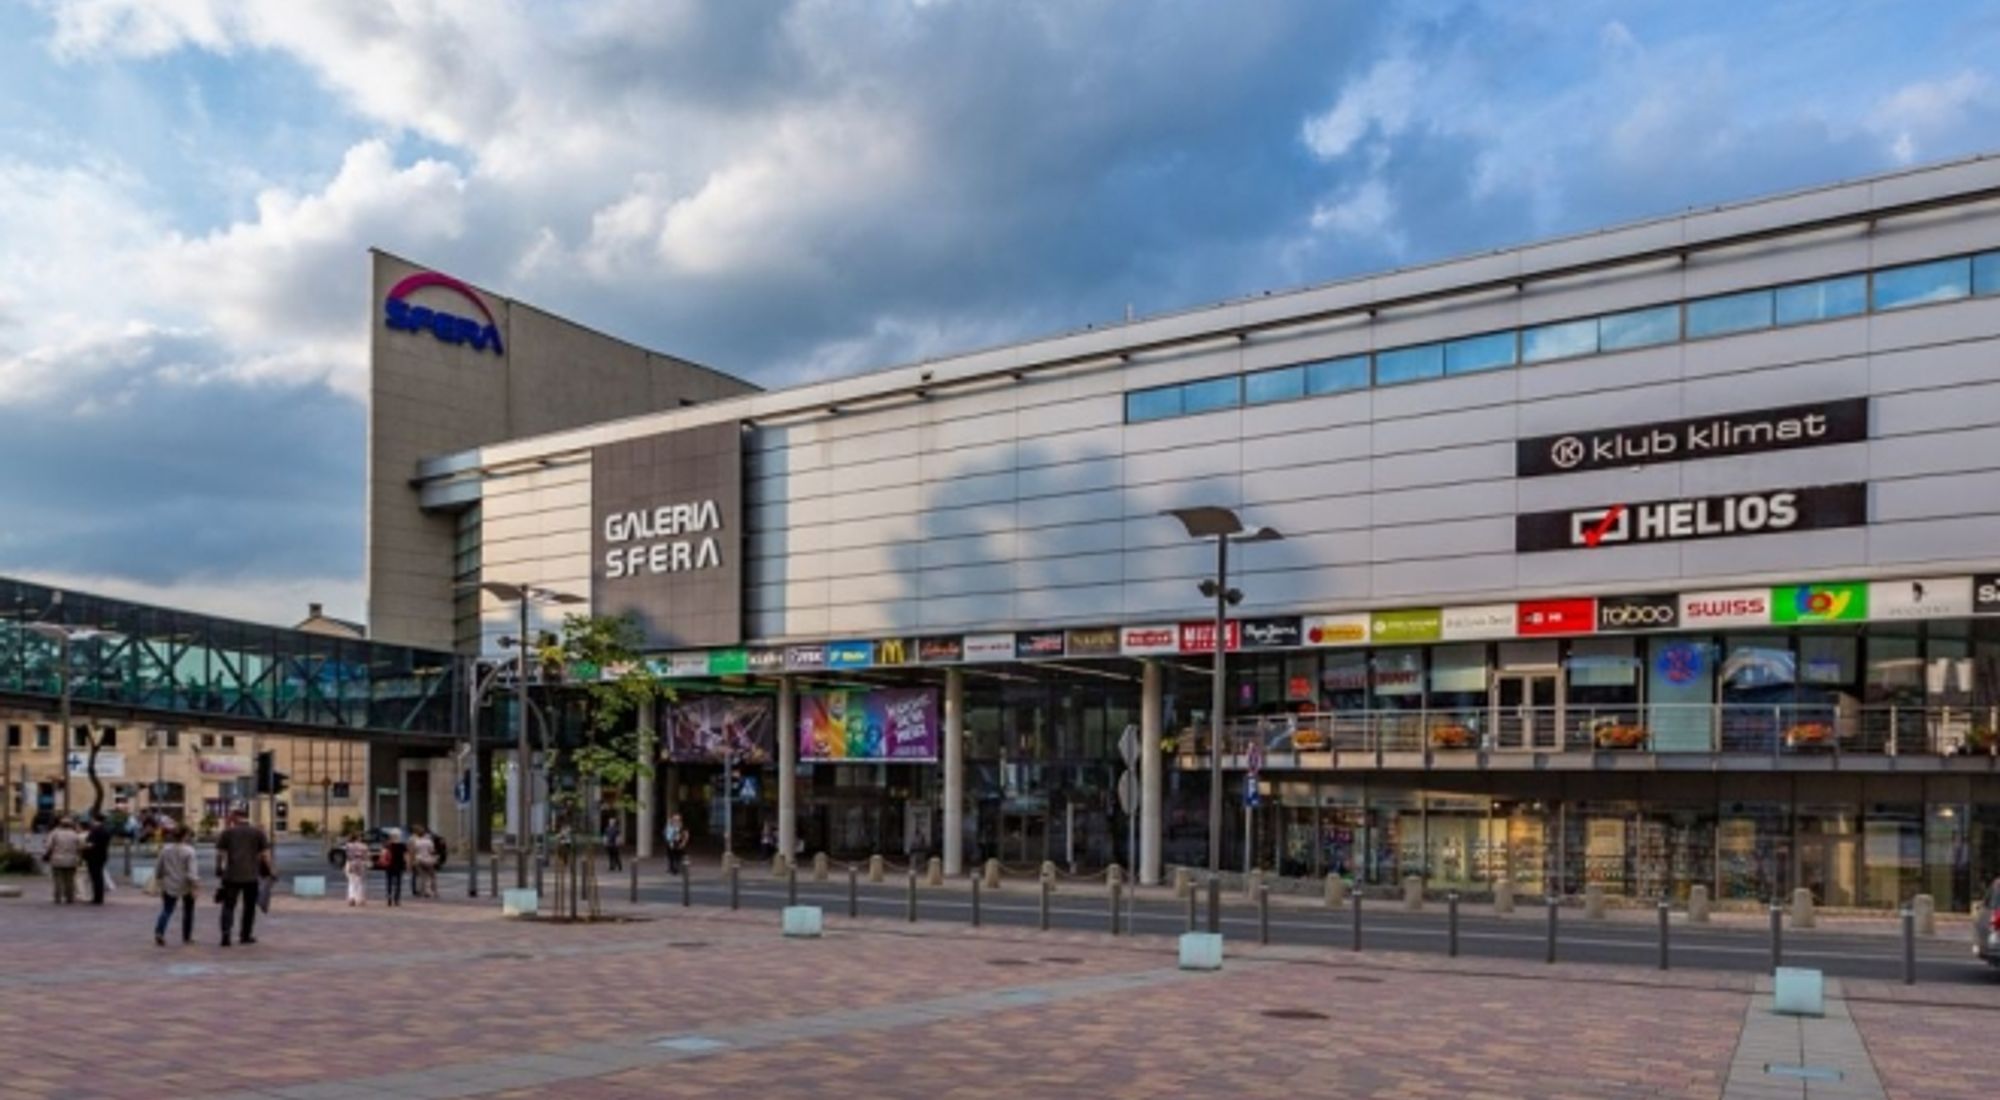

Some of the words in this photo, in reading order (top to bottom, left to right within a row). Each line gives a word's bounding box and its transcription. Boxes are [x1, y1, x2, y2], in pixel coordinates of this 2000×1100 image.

[385, 298, 504, 356] SFERA
[1593, 430, 1676, 460] klub
[1687, 413, 1827, 451] klimat
[605, 499, 720, 541] GALERIA
[1637, 493, 1798, 538] HELIOS
[605, 537, 720, 578] SFERA
[1687, 597, 1765, 618] SWISS
